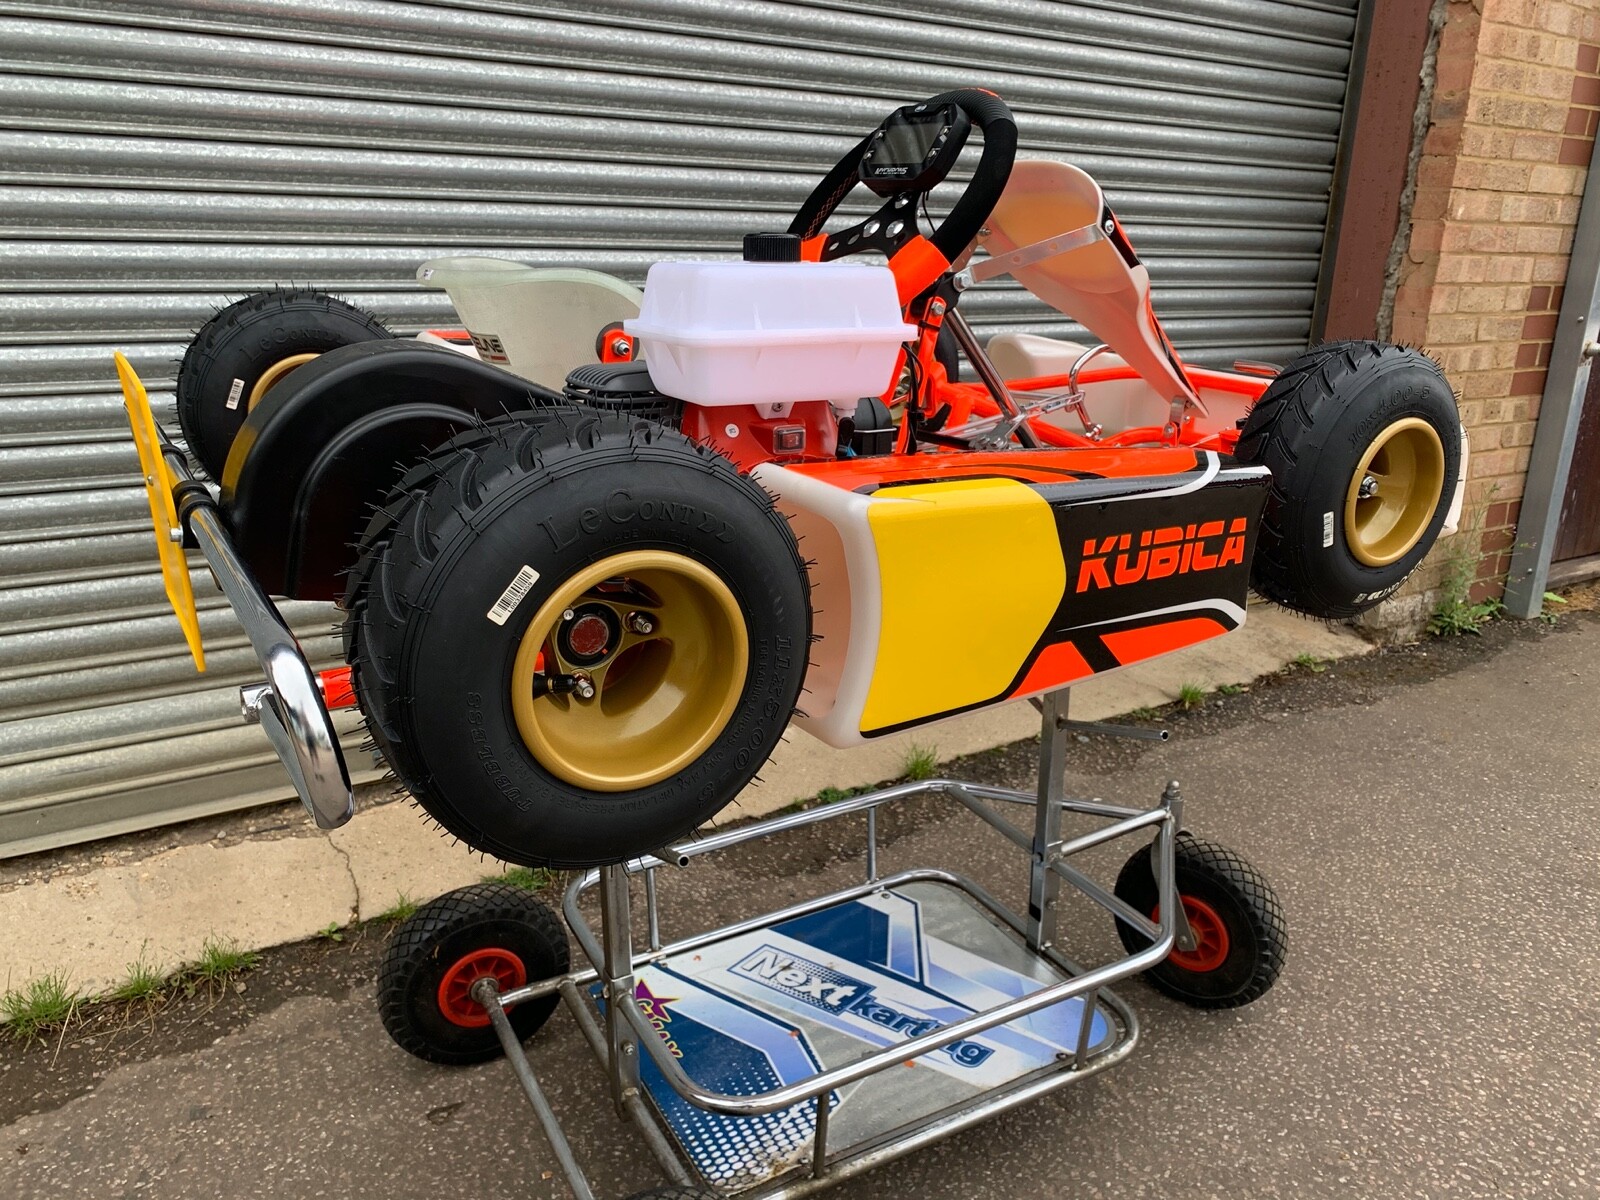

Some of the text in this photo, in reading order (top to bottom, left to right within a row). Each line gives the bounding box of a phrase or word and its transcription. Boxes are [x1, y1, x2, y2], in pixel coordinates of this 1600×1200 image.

[1076, 517, 1247, 593] KUBICA
[741, 950, 995, 1068] Next kartg
